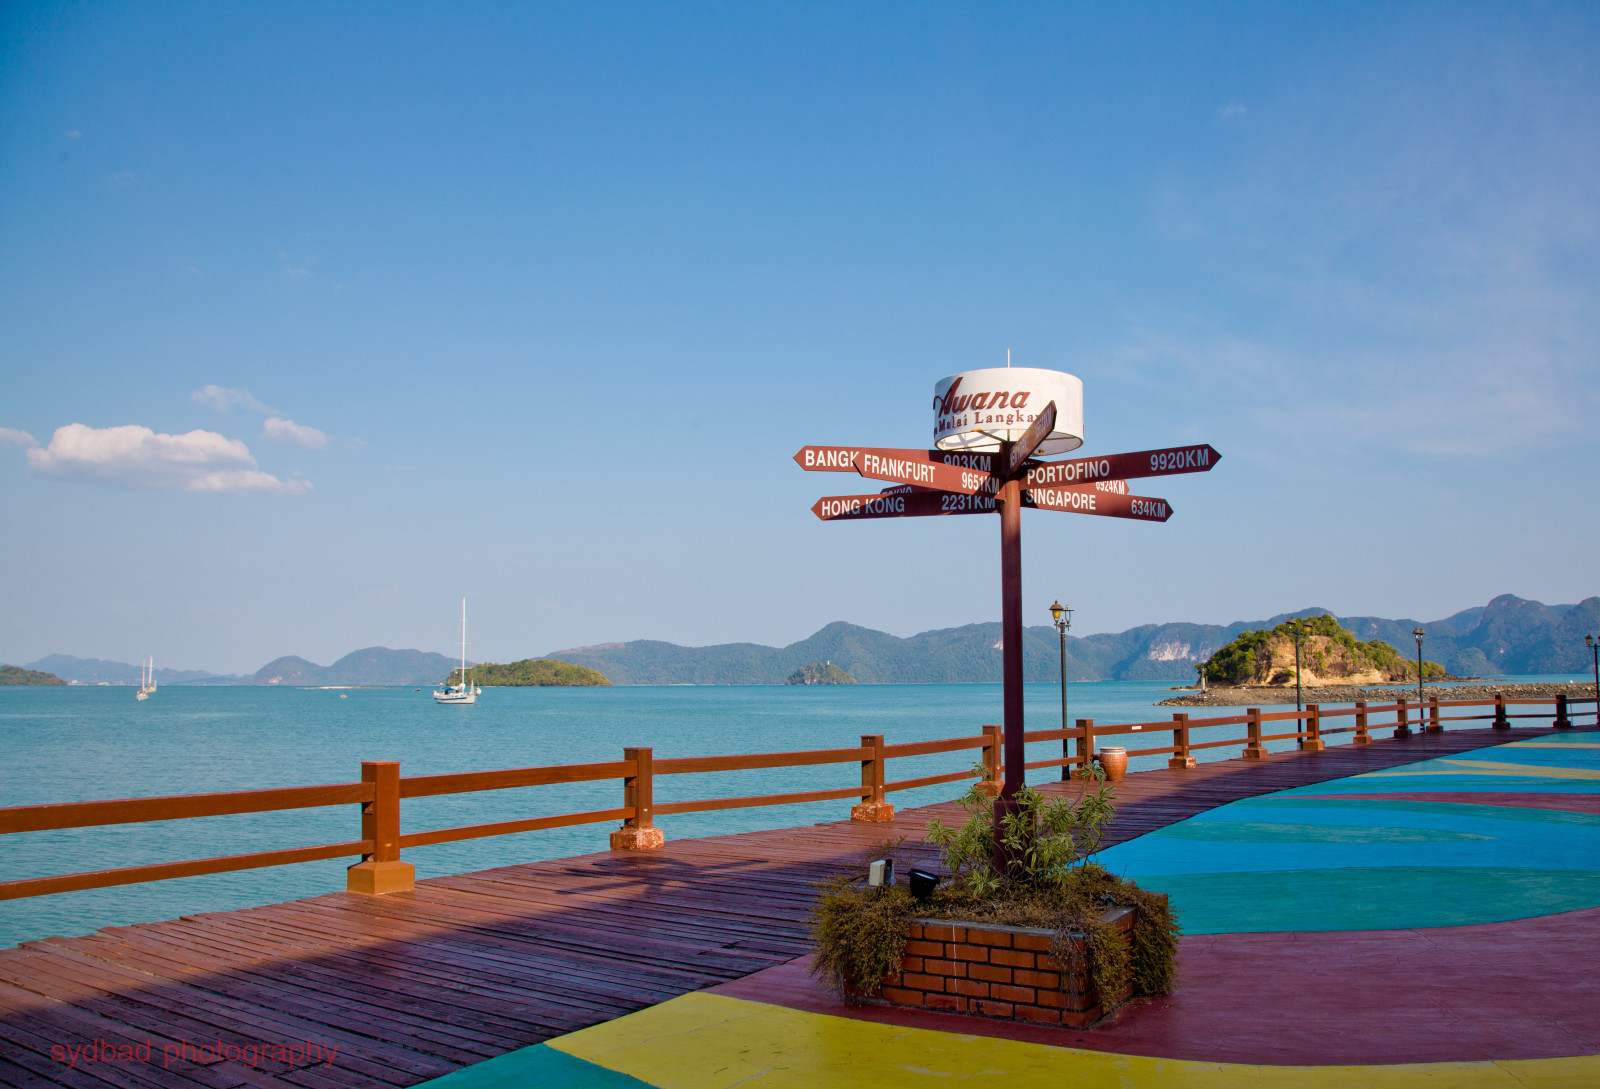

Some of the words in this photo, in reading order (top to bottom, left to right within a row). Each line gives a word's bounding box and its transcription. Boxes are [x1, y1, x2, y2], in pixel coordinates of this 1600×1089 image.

[933, 376, 1031, 418] Awana
[974, 409, 1040, 425] Langka
[805, 450, 859, 467] BANGK
[943, 454, 991, 472] 903KM
[864, 454, 936, 483] FRANKFURT
[961, 471, 1000, 494] 9651KM
[1027, 459, 1110, 485] PORTOFINO
[1150, 448, 1209, 471] 9920KM
[821, 499, 861, 516] HONG
[865, 497, 905, 514] KONG
[941, 494, 996, 511] 2231KM
[1025, 488, 1097, 511] SINGAPORE
[1131, 499, 1166, 518] 634KM
